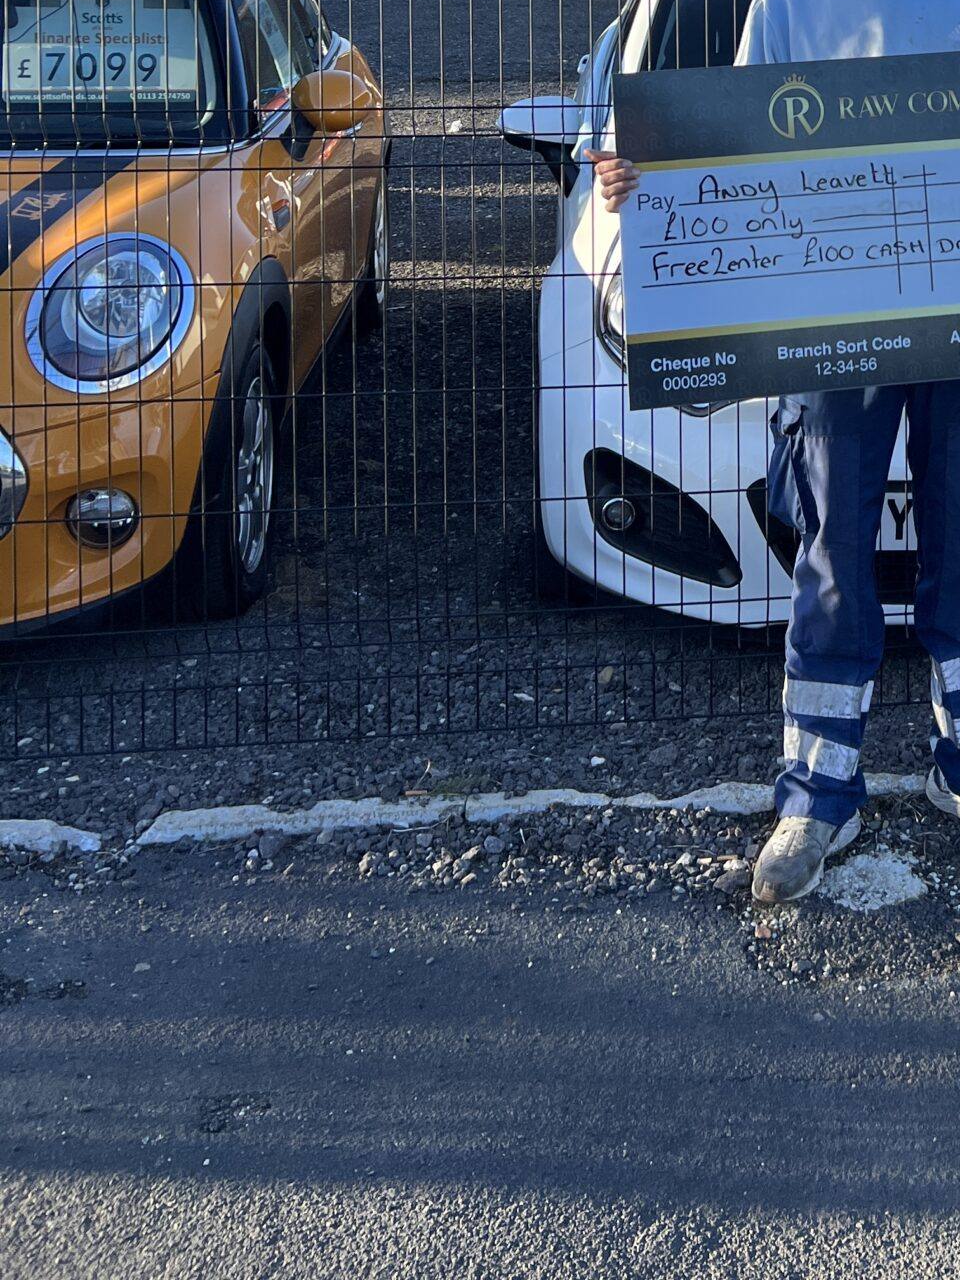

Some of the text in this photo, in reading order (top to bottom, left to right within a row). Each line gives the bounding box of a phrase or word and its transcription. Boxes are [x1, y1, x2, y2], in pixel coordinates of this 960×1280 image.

[82, 12, 124, 24] Scott's
[838, 93, 899, 120] RAW
[637, 193, 675, 214] Pay
[664, 210, 804, 242] £100 only
[803, 237, 854, 268] £100
[777, 335, 912, 361] Branch Sort Code
[650, 352, 737, 373] Cheque No
[814, 357, 878, 377] 12-34-56
[663, 372, 727, 391] 0000293
